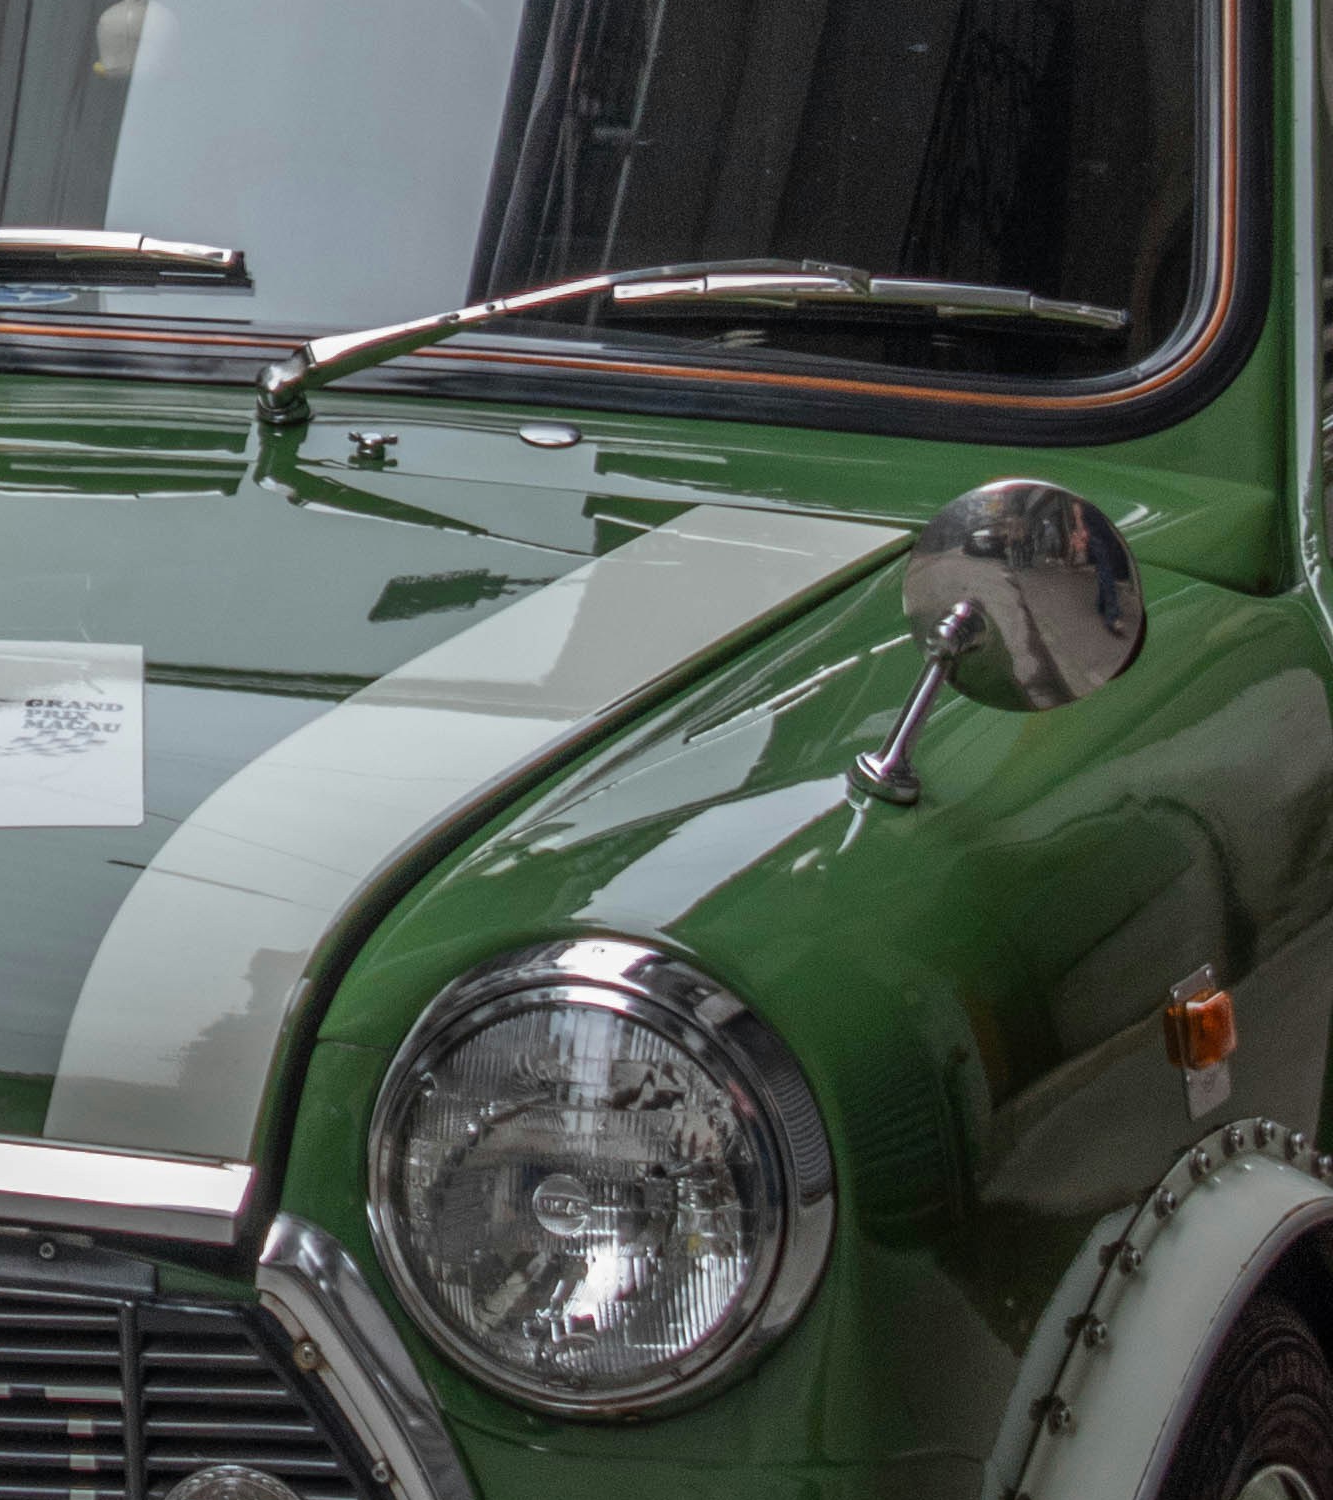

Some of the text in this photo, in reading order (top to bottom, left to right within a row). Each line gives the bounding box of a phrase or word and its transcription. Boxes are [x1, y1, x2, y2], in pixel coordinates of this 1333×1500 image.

[24, 698, 124, 713] GRAND
[24, 709, 91, 721] PRIX
[21, 718, 122, 734] MACAU
